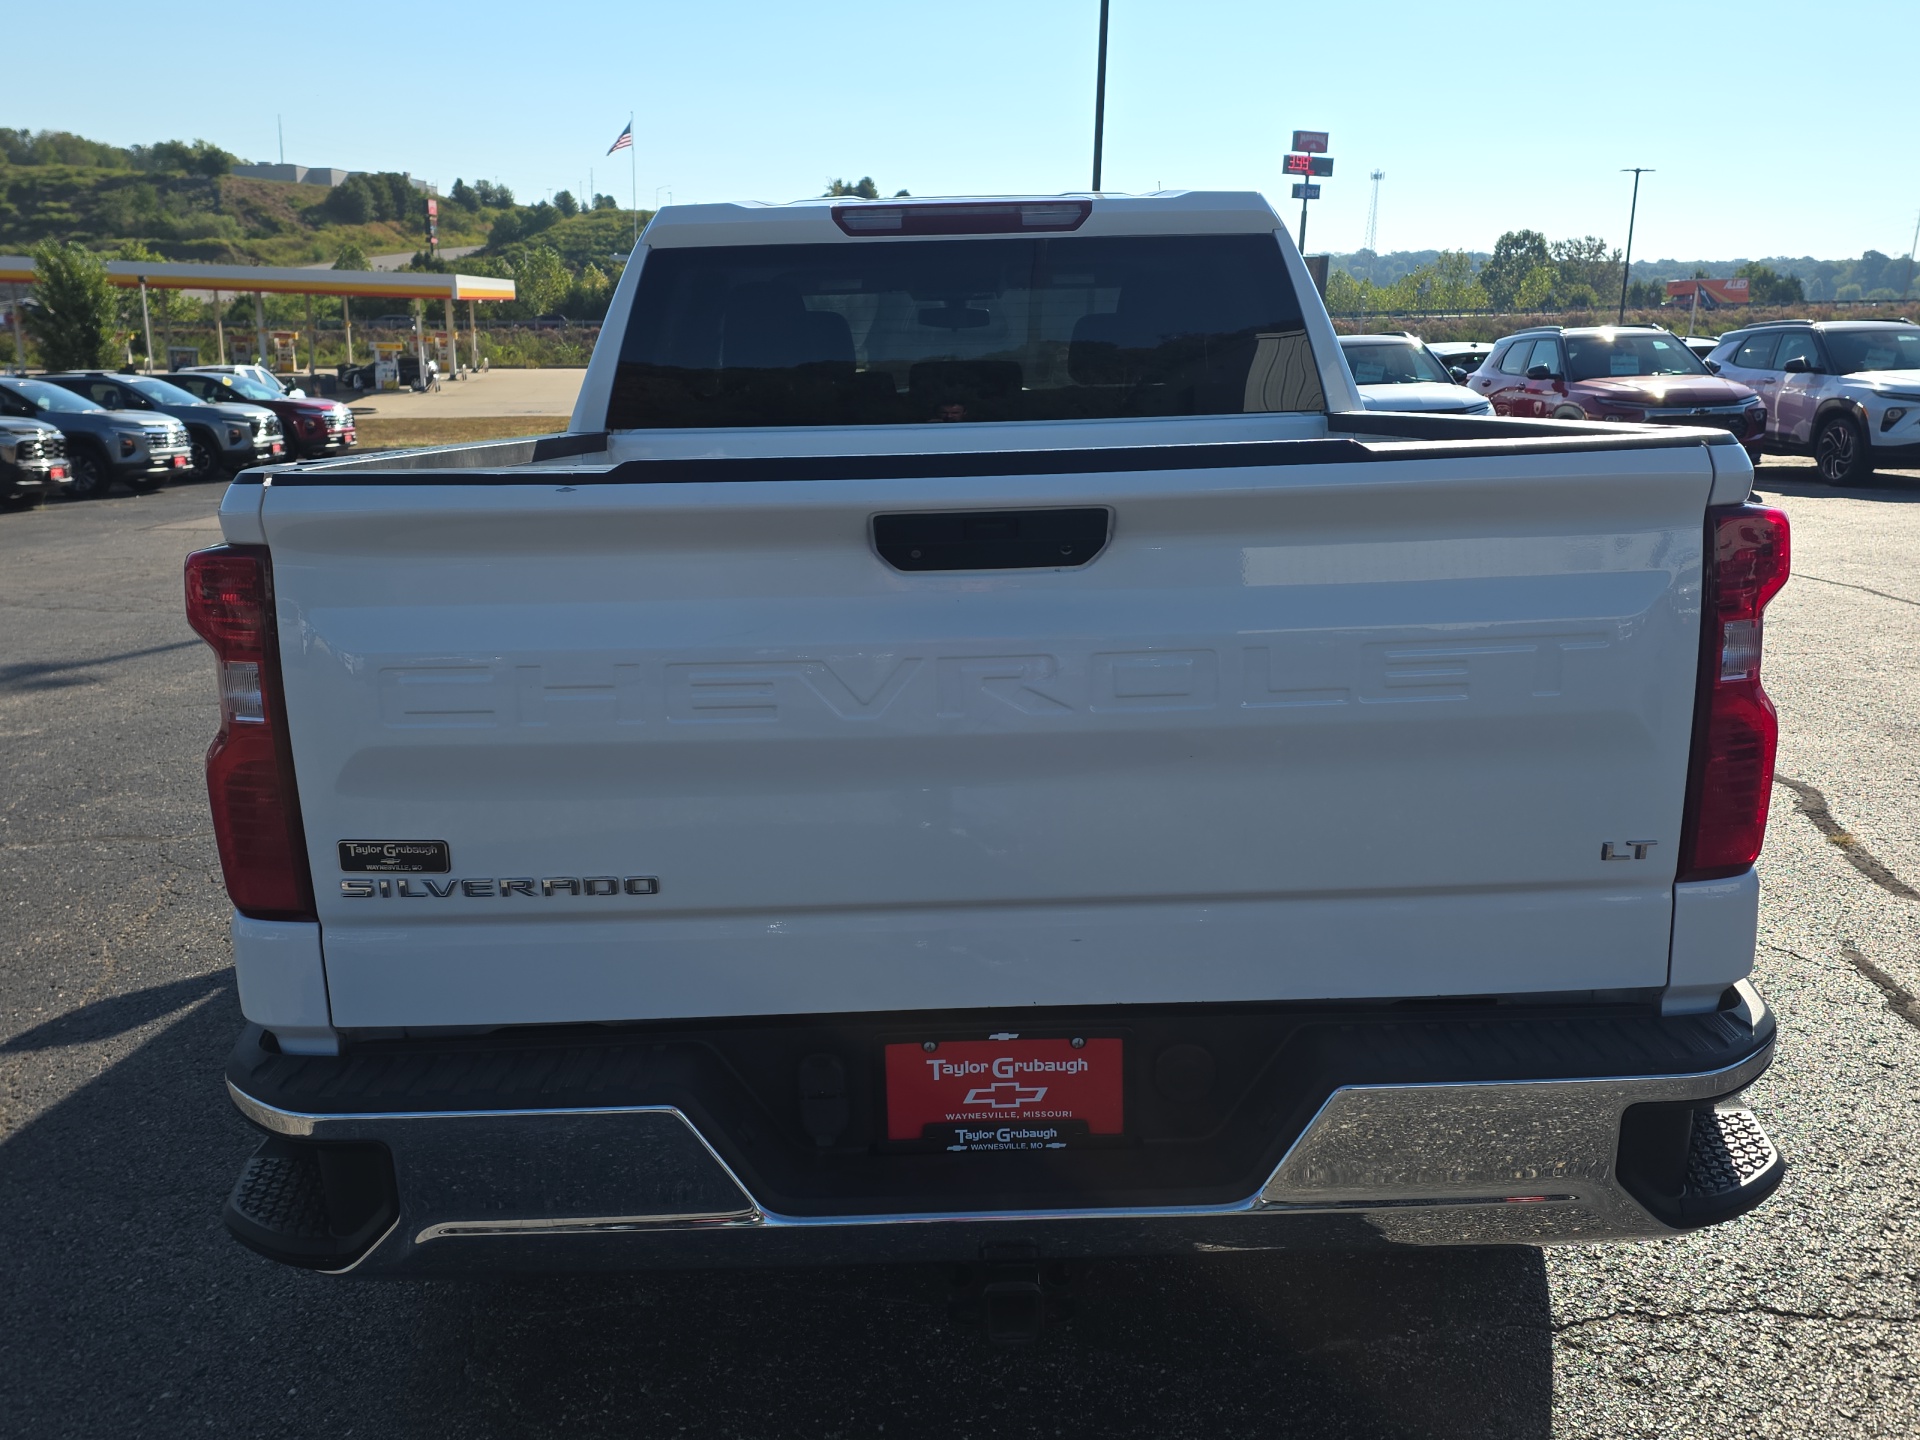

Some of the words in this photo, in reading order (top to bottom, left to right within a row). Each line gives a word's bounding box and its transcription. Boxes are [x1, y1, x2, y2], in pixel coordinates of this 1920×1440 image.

[378, 633, 1610, 727] CHEVROLET
[346, 844, 382, 857] Taylor
[383, 843, 438, 857] Grubaugh
[1601, 840, 1658, 861] LT
[340, 876, 660, 898] SILVERADO
[926, 1059, 989, 1081] Taylor
[992, 1057, 1088, 1079] Grubaugh
[945, 1112, 1020, 1121] WAYNESVILLE,
[1023, 1110, 1073, 1118] MISSOURI
[955, 1129, 995, 1143] Taylor
[996, 1128, 1057, 1142] Grubaugh
[970, 1143, 1029, 1151] WAYNESVILLE,
[1030, 1142, 1043, 1150] MO
